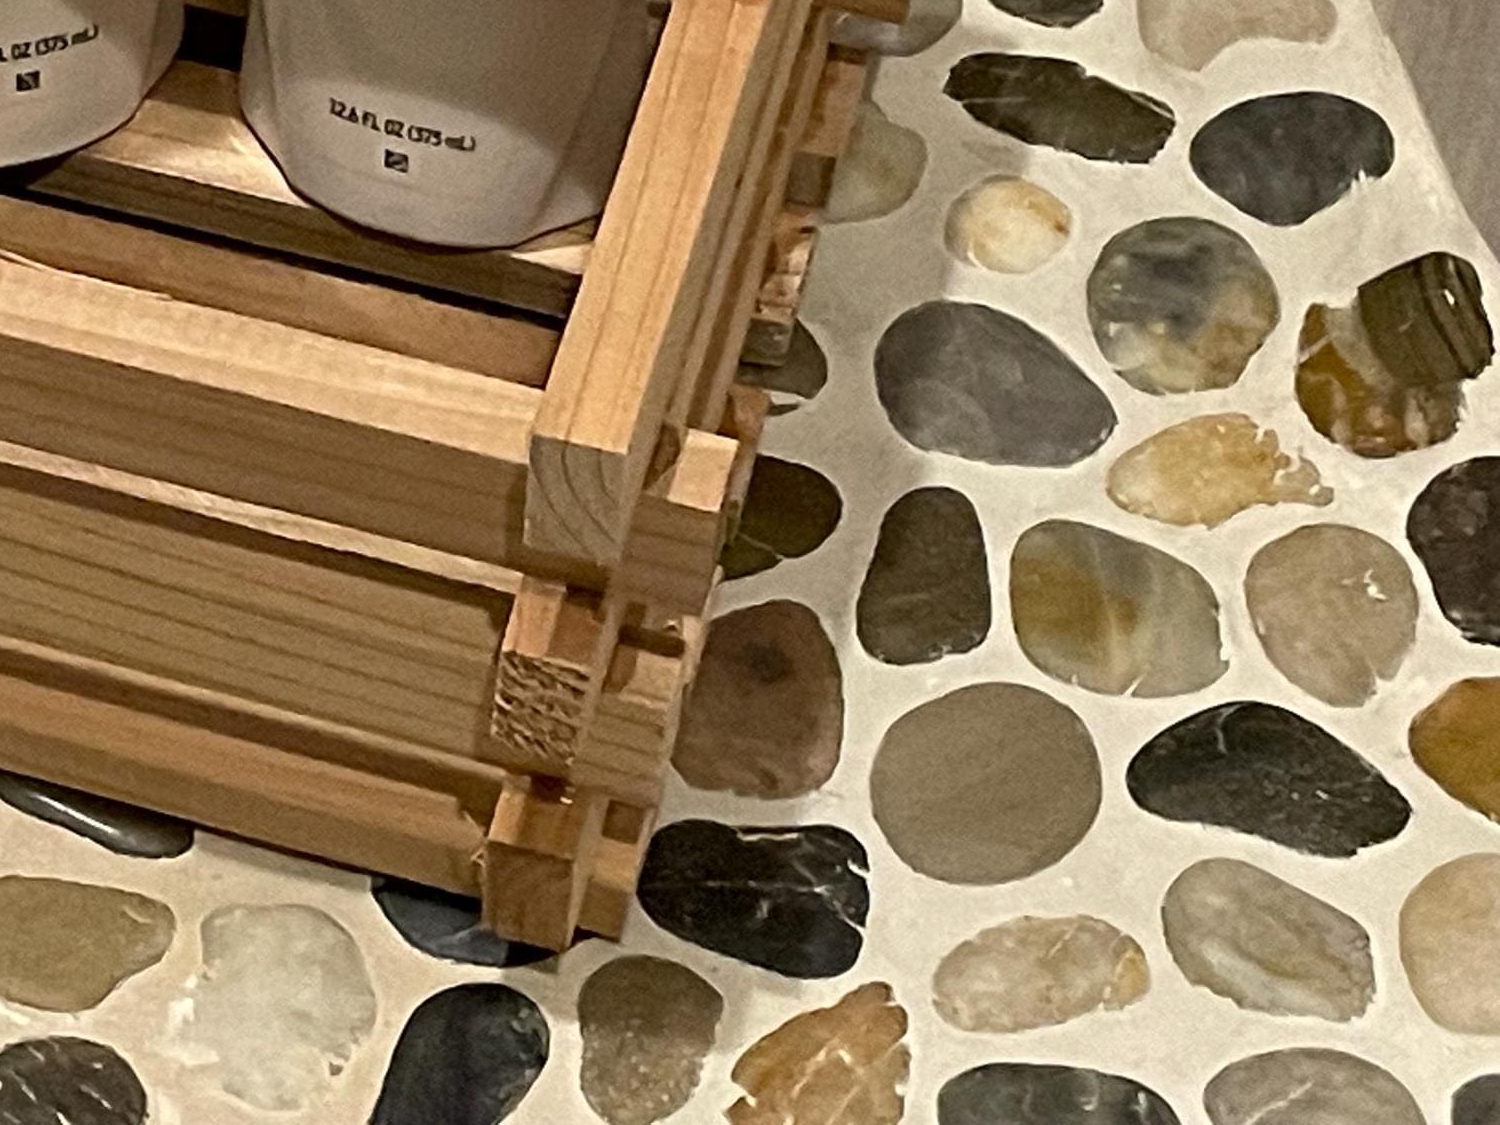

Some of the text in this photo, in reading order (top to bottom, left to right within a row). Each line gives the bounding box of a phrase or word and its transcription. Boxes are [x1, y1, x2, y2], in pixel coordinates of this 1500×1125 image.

[11, 41, 33, 61] OZ
[329, 96, 360, 124] 12.6
[362, 110, 382, 133] FL
[384, 118, 405, 139] OZ
